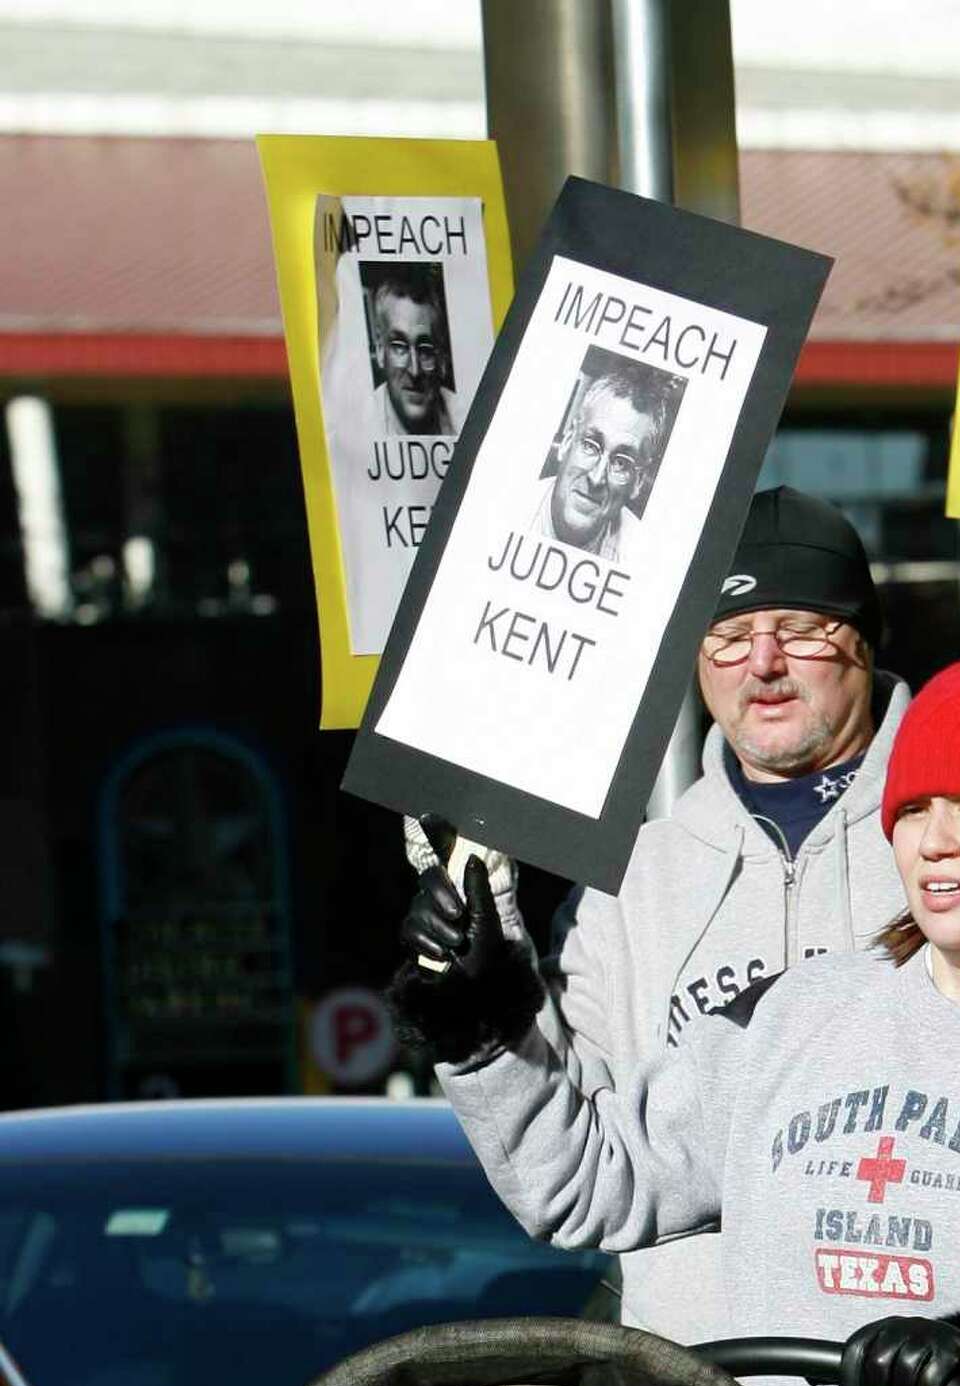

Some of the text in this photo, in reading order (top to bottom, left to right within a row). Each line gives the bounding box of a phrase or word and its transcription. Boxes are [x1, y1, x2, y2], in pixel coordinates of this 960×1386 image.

[323, 214, 467, 255] IMPEACH
[553, 281, 740, 380] IMPEACH
[367, 441, 457, 481] JUDG
[488, 531, 633, 618] JUDGE
[472, 599, 598, 682] KENT
[333, 1004, 379, 1066] P
[771, 1084, 890, 1173] SOUTH
[805, 1160, 853, 1177] LIFE
[813, 1207, 934, 1252] ISLAND
[817, 1254, 931, 1297] TEXAS
